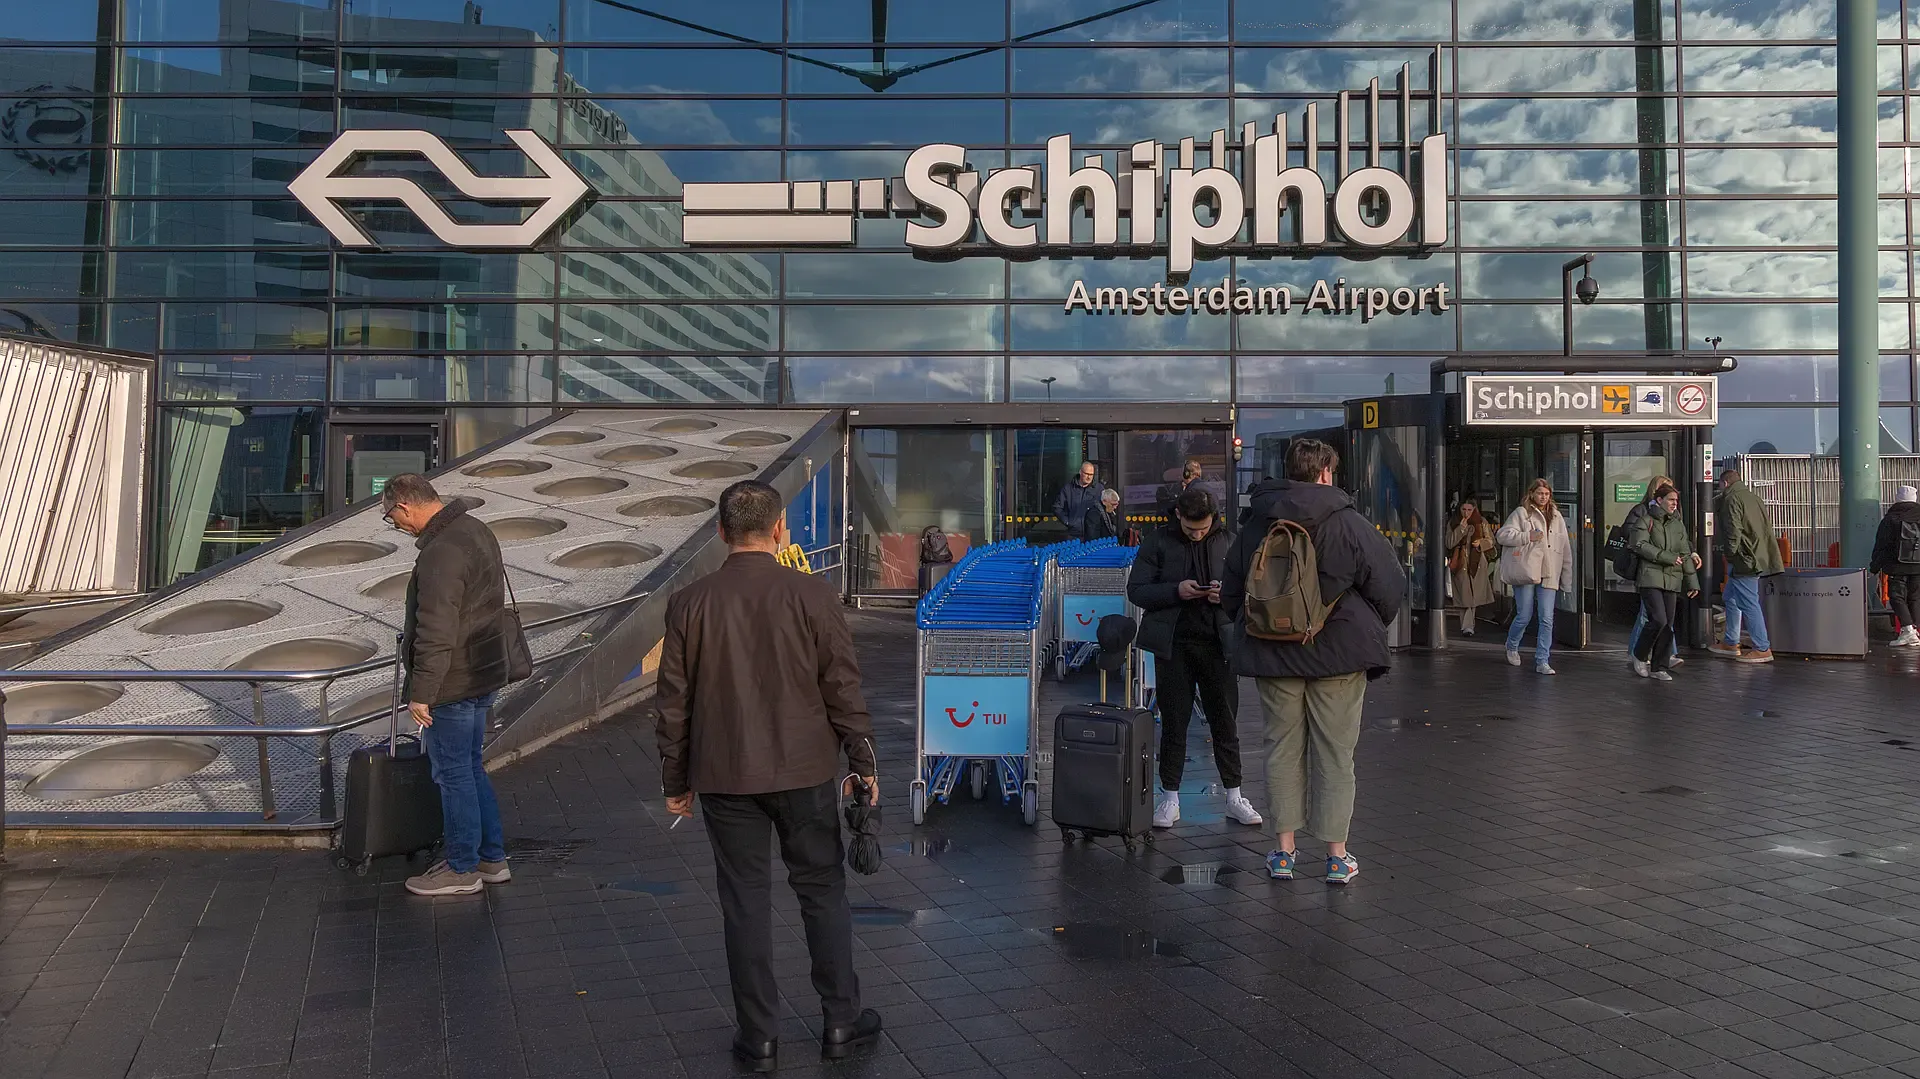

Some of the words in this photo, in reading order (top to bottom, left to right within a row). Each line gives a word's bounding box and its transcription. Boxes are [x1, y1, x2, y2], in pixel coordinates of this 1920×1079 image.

[903, 133, 1449, 275] Schiphol
[1065, 279, 1291, 312] Amsterdam
[1302, 279, 1450, 321] Airport
[1366, 405, 1375, 425] D
[1478, 386, 1597, 415] Schiphol
[982, 713, 1007, 725] TUI
